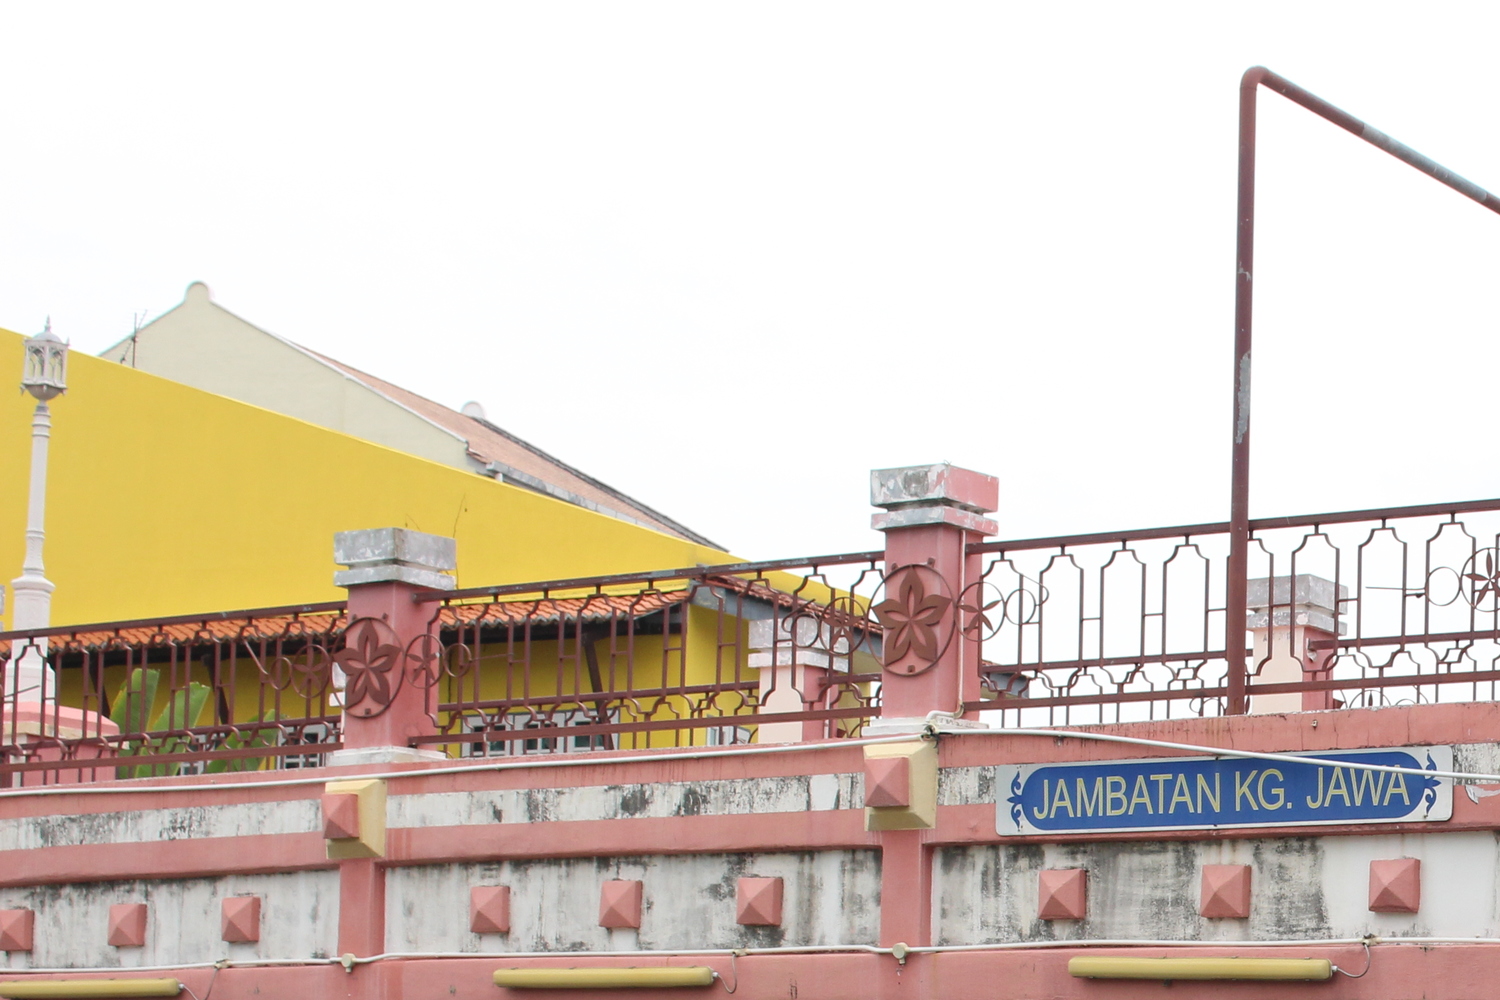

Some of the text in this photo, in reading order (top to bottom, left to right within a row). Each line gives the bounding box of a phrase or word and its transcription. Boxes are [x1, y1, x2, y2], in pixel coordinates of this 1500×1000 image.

[1033, 765, 1411, 820] JAMBATAN KG. JAWA
